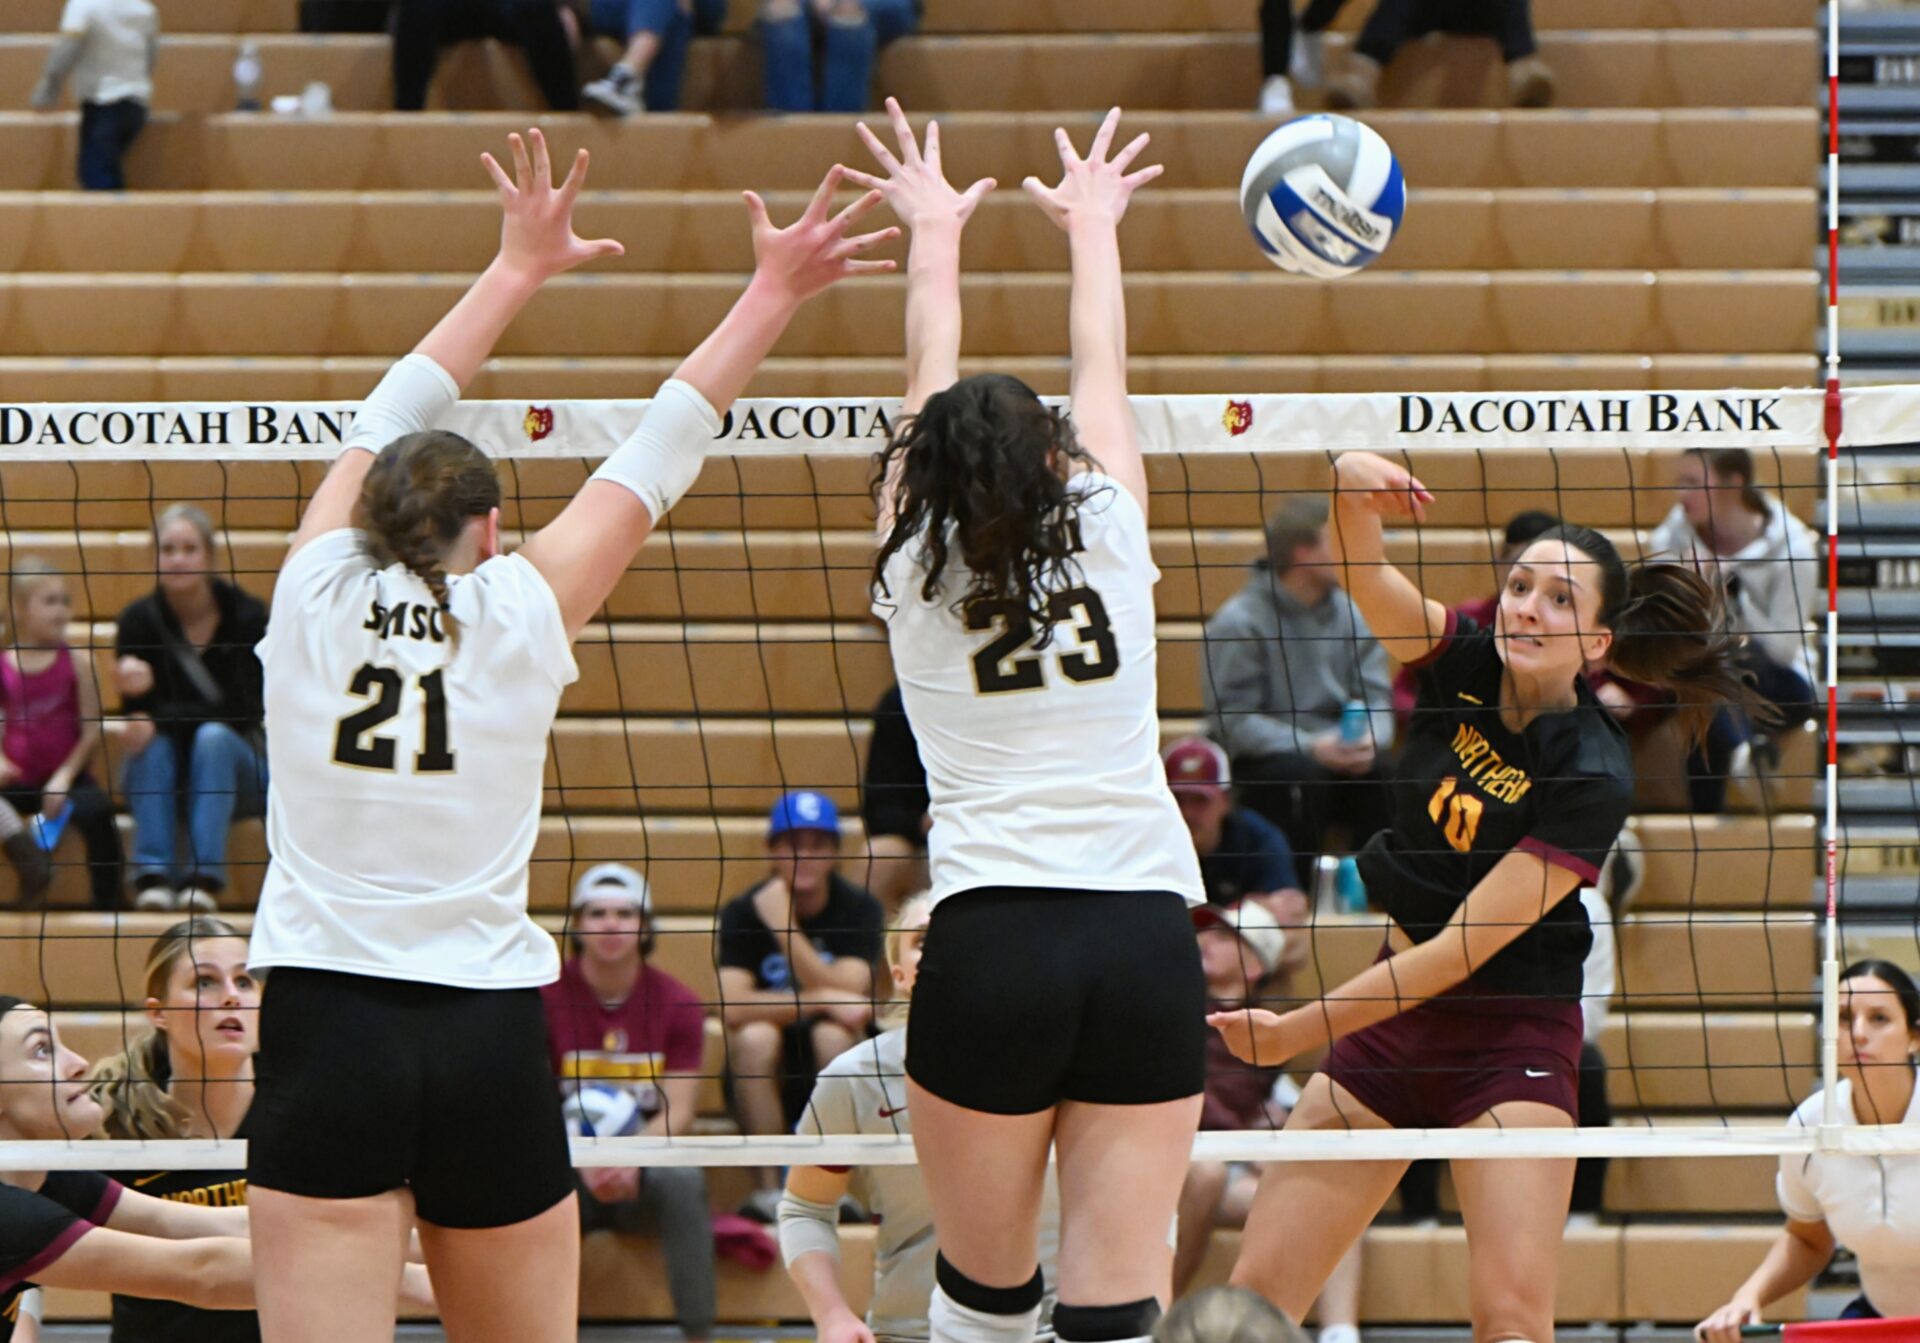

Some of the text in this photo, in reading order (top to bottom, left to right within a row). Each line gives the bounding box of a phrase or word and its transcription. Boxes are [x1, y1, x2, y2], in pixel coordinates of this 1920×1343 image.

[0, 407, 230, 445] DACOTAH
[1398, 393, 1781, 434] DACOTAH BANK
[963, 583, 1119, 696] 23
[332, 663, 458, 775] 21
[1427, 776, 1484, 853] 10
